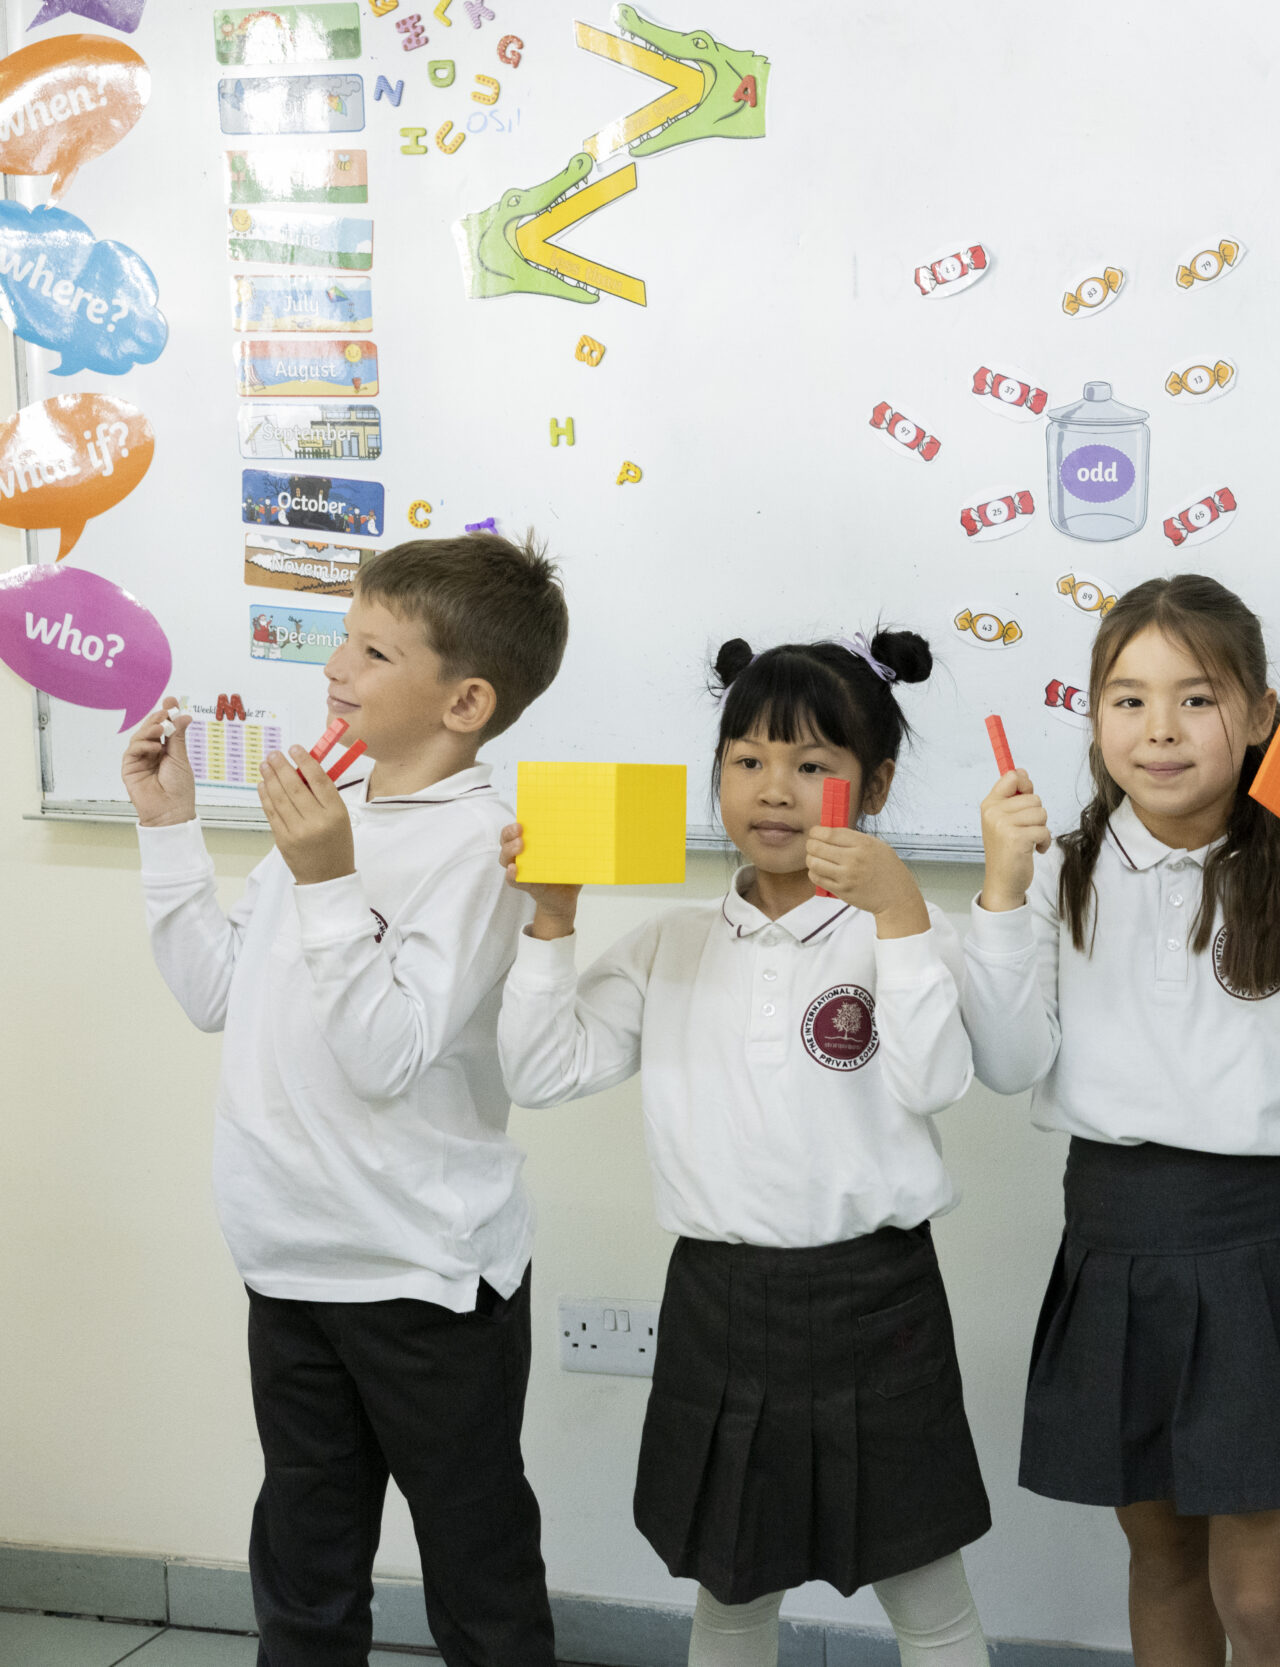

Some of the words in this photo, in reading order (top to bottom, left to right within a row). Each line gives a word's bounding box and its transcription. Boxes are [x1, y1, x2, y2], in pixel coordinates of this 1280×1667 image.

[497, 35, 524, 68] G
[428, 60, 455, 88] D
[374, 75, 404, 107] N
[733, 74, 757, 107] A
[1200, 260, 1212, 271] 79
[1087, 287, 1098, 299] 83
[283, 294, 320, 317] July
[574, 334, 606, 367] B
[275, 361, 337, 382] August
[1193, 375, 1204, 385] 13
[1004, 385, 1016, 396] 37
[263, 423, 354, 442] September
[550, 417, 575, 447] H
[900, 426, 911, 437] 97
[84, 421, 129, 477] if?
[616, 460, 643, 486] P
[1077, 461, 1118, 482] odd
[277, 492, 347, 514] October
[408, 499, 432, 528] C
[991, 507, 1003, 517] 25
[271, 556, 358, 582] November
[1081, 592, 1093, 601] 89
[276, 627, 347, 648] Decemb
[981, 624, 993, 632] 43
[26, 611, 125, 668] who?
[192, 704, 217, 716] Weekl
[216, 693, 246, 721] M
[1077, 697, 1088, 707] 75
[805, 988, 850, 1036] INTERNATIONAL
[807, 1038, 818, 1054] THE
[819, 1053, 859, 1068] PRIVATE
